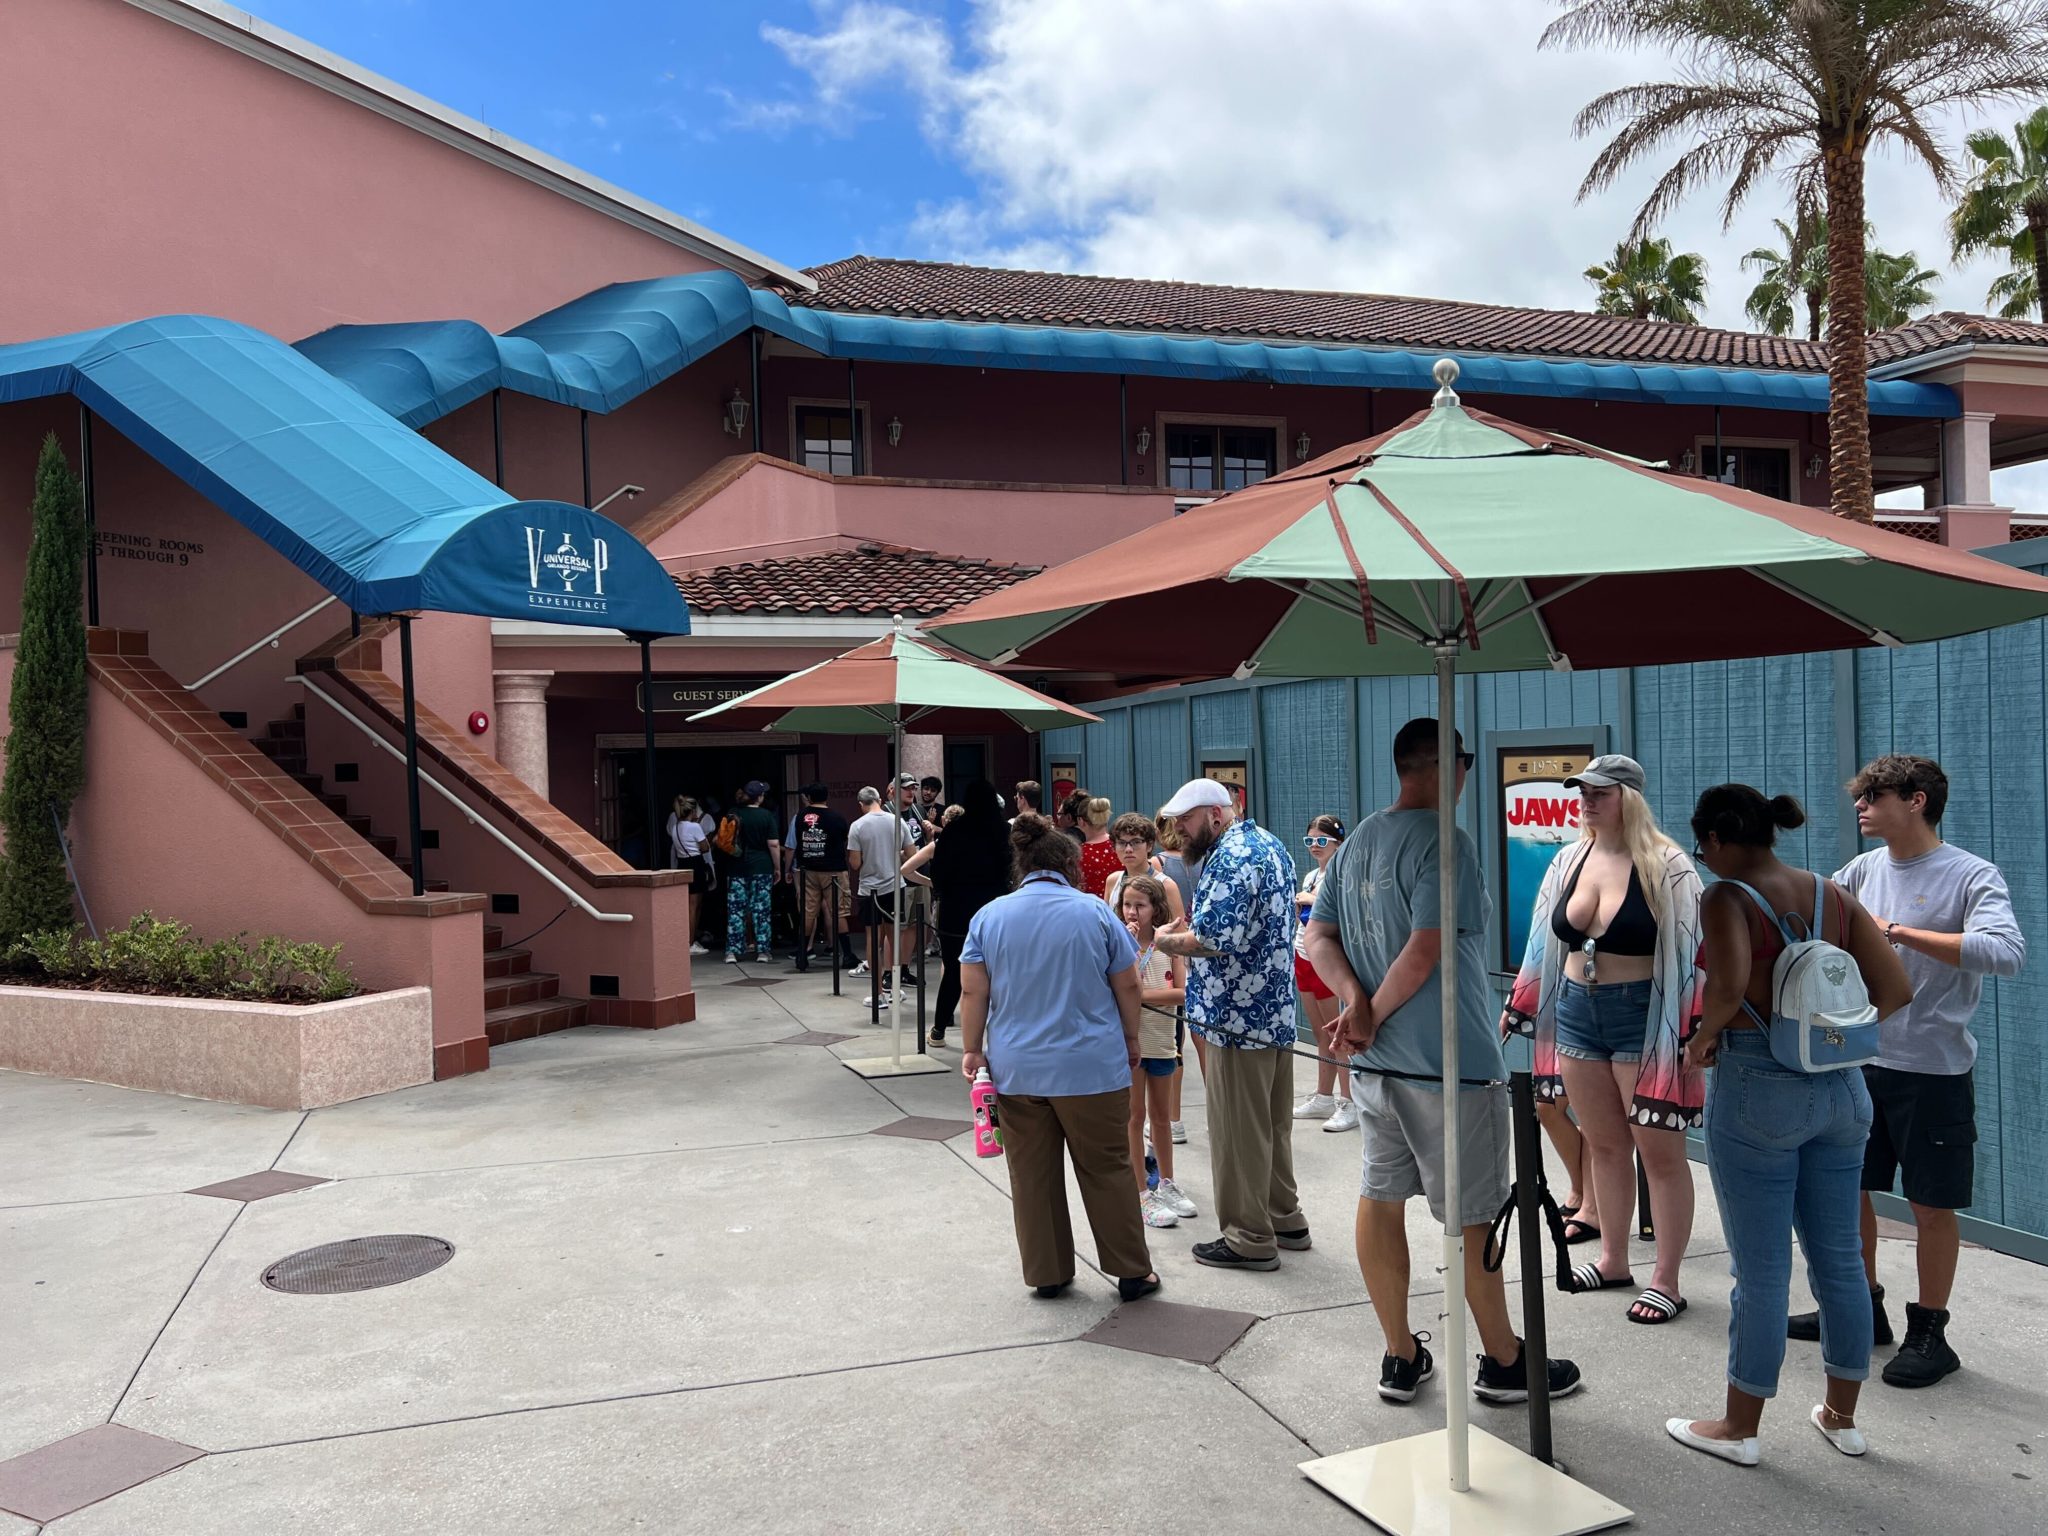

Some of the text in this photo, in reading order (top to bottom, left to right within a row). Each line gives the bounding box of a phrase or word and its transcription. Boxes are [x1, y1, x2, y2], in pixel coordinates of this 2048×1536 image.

[1137, 465, 1145, 476] 5
[93, 532, 204, 554] REENING ROOMS
[109, 546, 174, 564] THROUGH
[179, 553, 189, 567] 9
[524, 526, 608, 595] VIP
[543, 554, 592, 568] UNIVERSAL
[529, 595, 607, 610] EXPERIENCE
[673, 690, 715, 701] GUEST
[1532, 760, 1559, 775] 1975
[1507, 797, 1580, 829] JAWS
